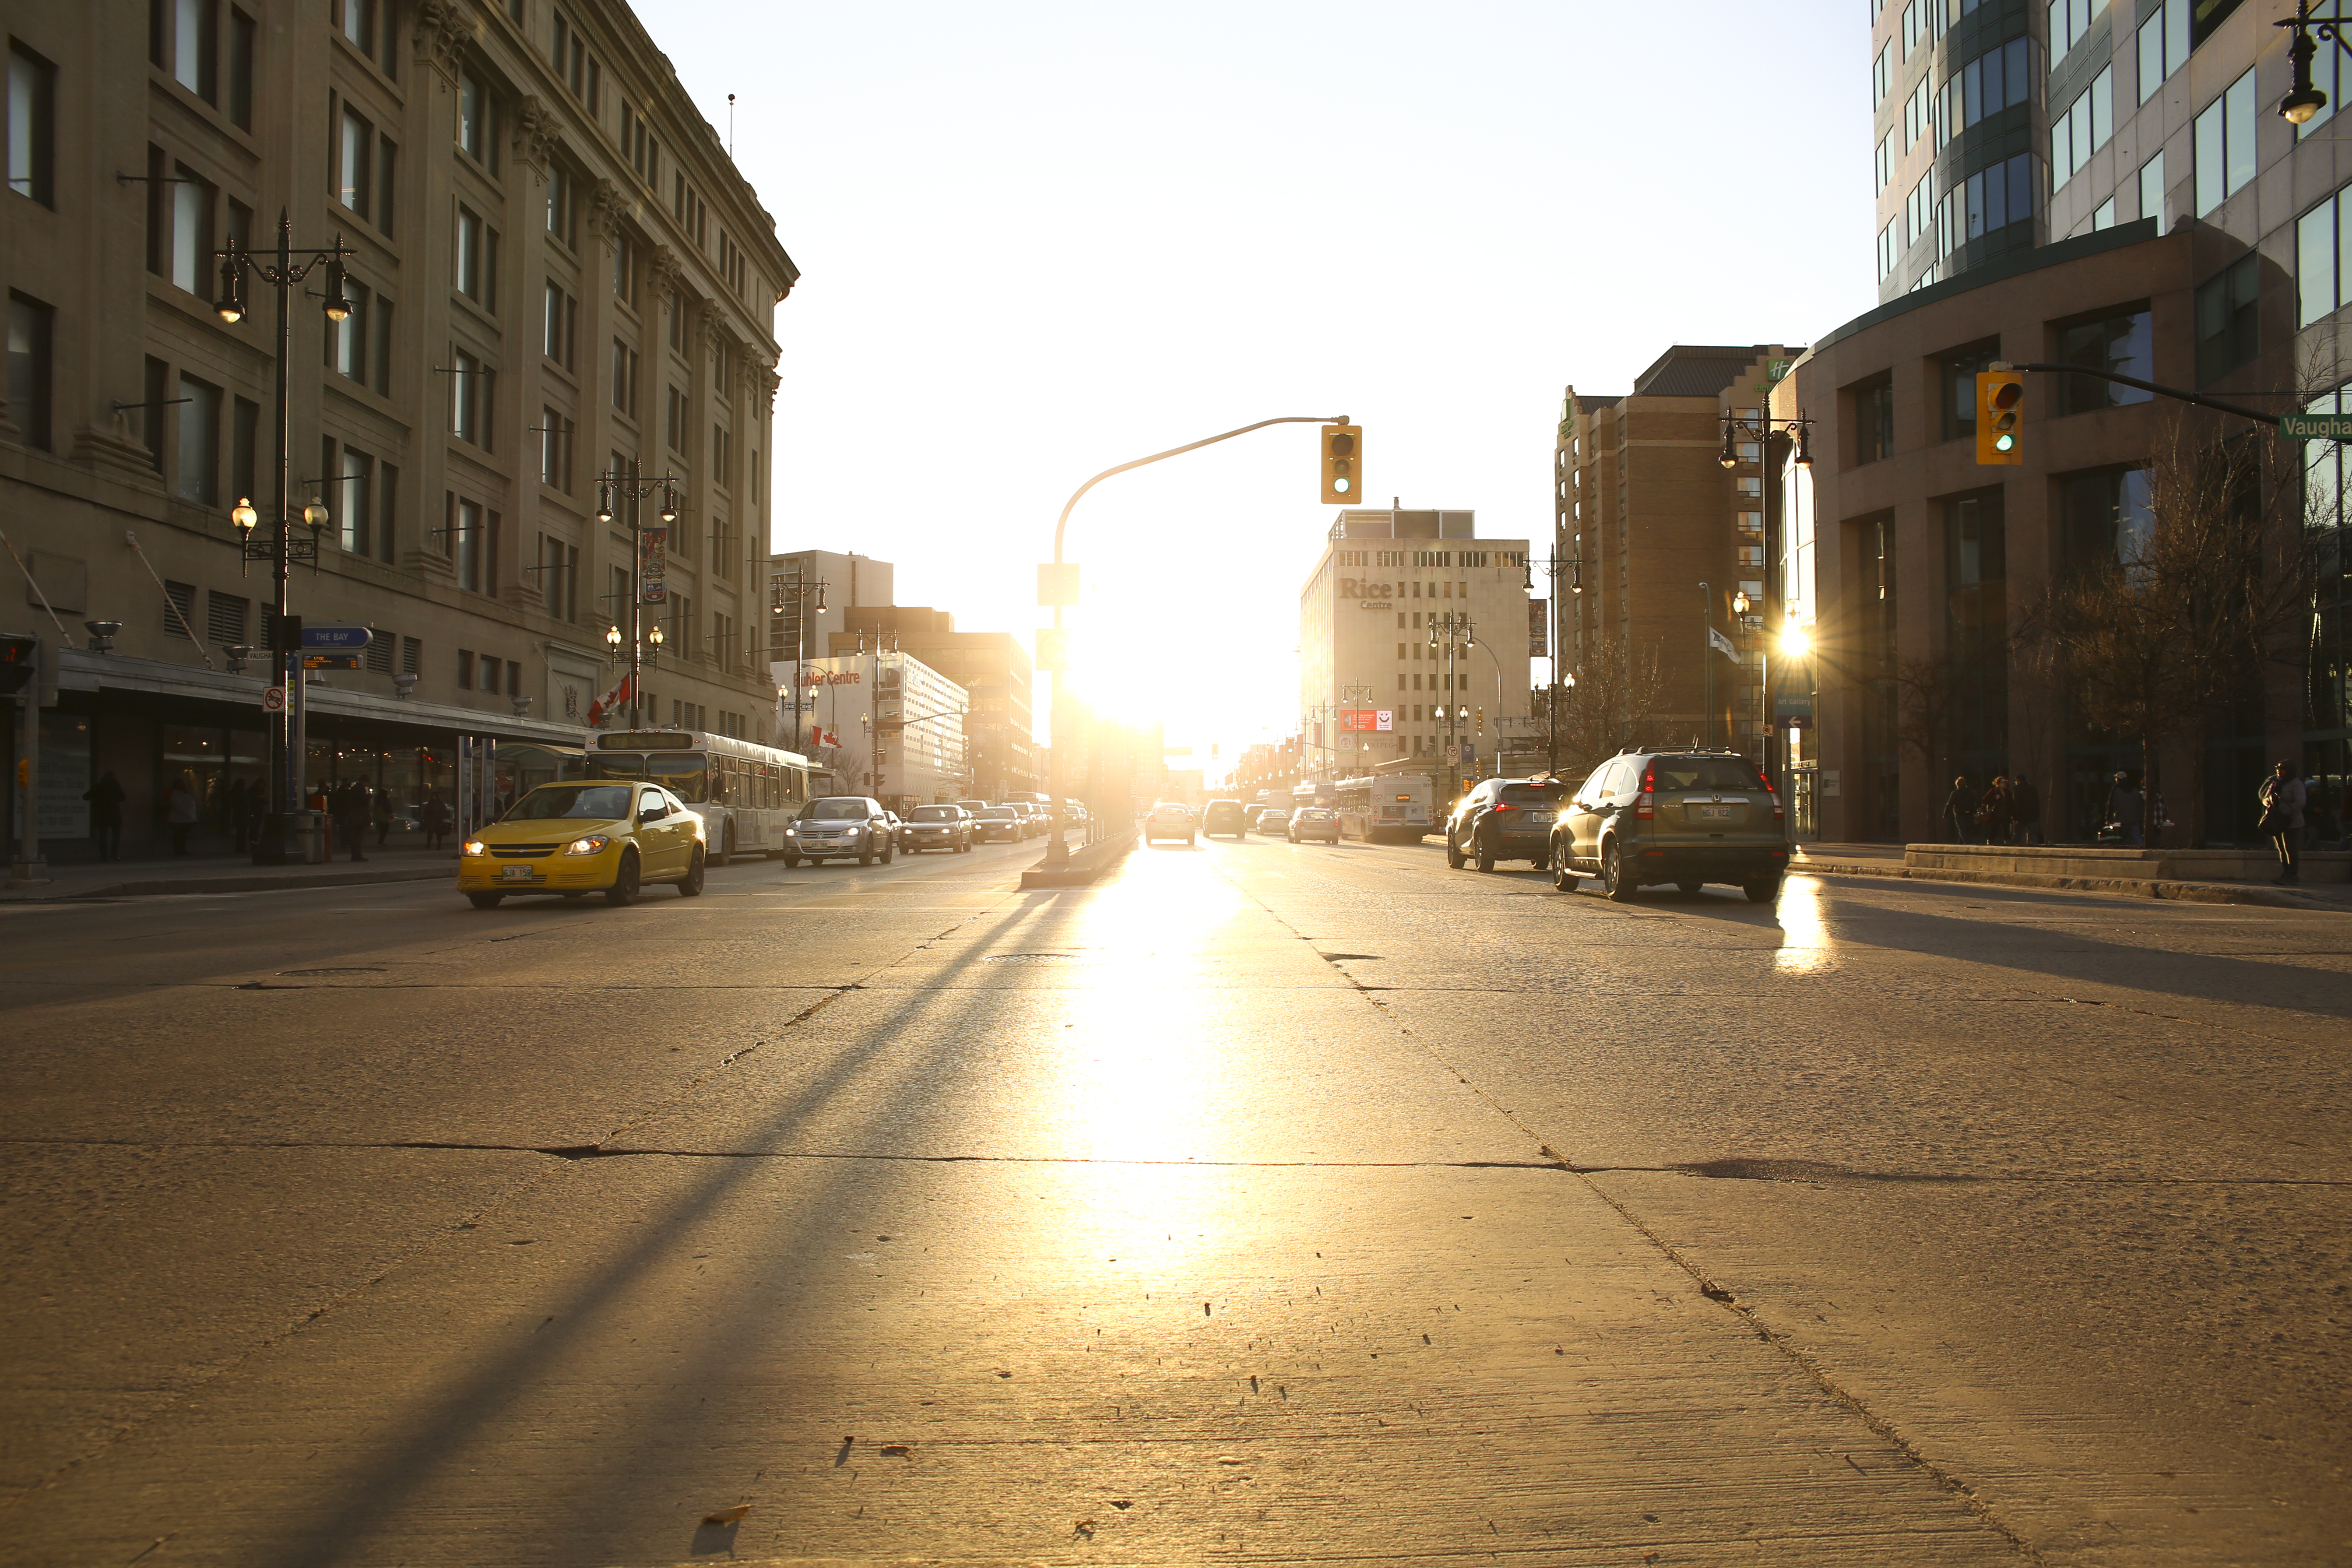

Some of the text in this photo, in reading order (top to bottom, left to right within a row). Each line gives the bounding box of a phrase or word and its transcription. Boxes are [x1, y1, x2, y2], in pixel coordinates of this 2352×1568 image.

[2284, 418, 2352, 438] Vaugha
[1339, 578, 1392, 598] Rice
[1361, 600, 1392, 609] Centre
[827, 670, 860, 685] Centre
[610, 736, 624, 745] 67
